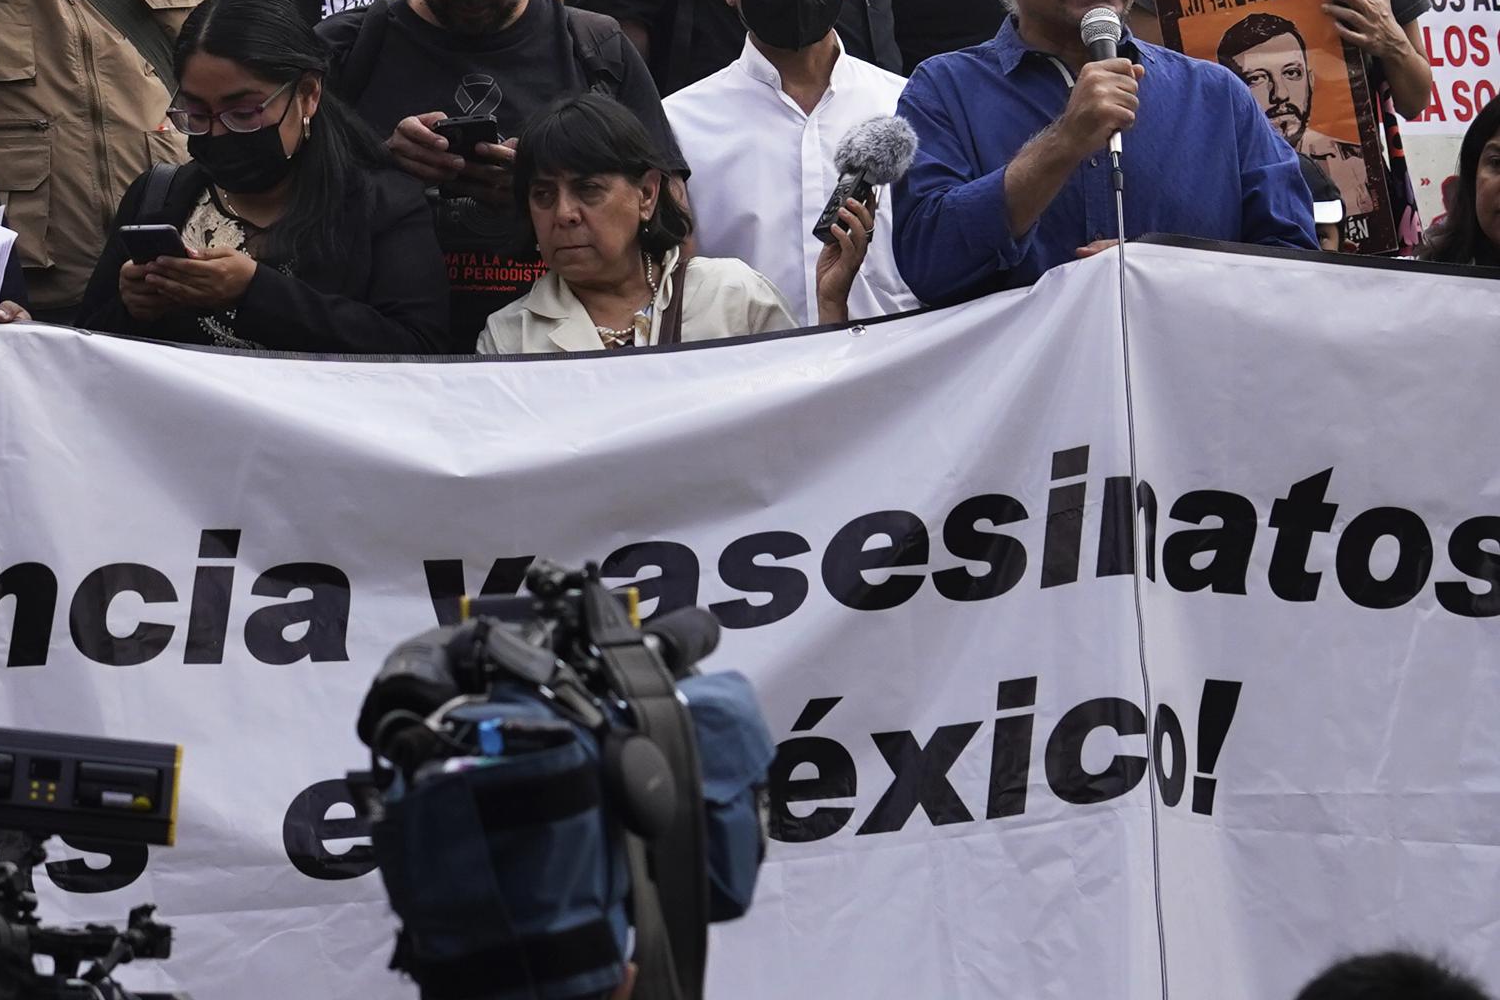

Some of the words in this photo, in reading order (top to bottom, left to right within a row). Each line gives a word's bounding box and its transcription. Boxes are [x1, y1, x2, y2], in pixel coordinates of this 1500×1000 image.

[1422, 24, 1491, 67] LOS
[282, 777, 378, 882] e
[767, 675, 1243, 843] éxico!
